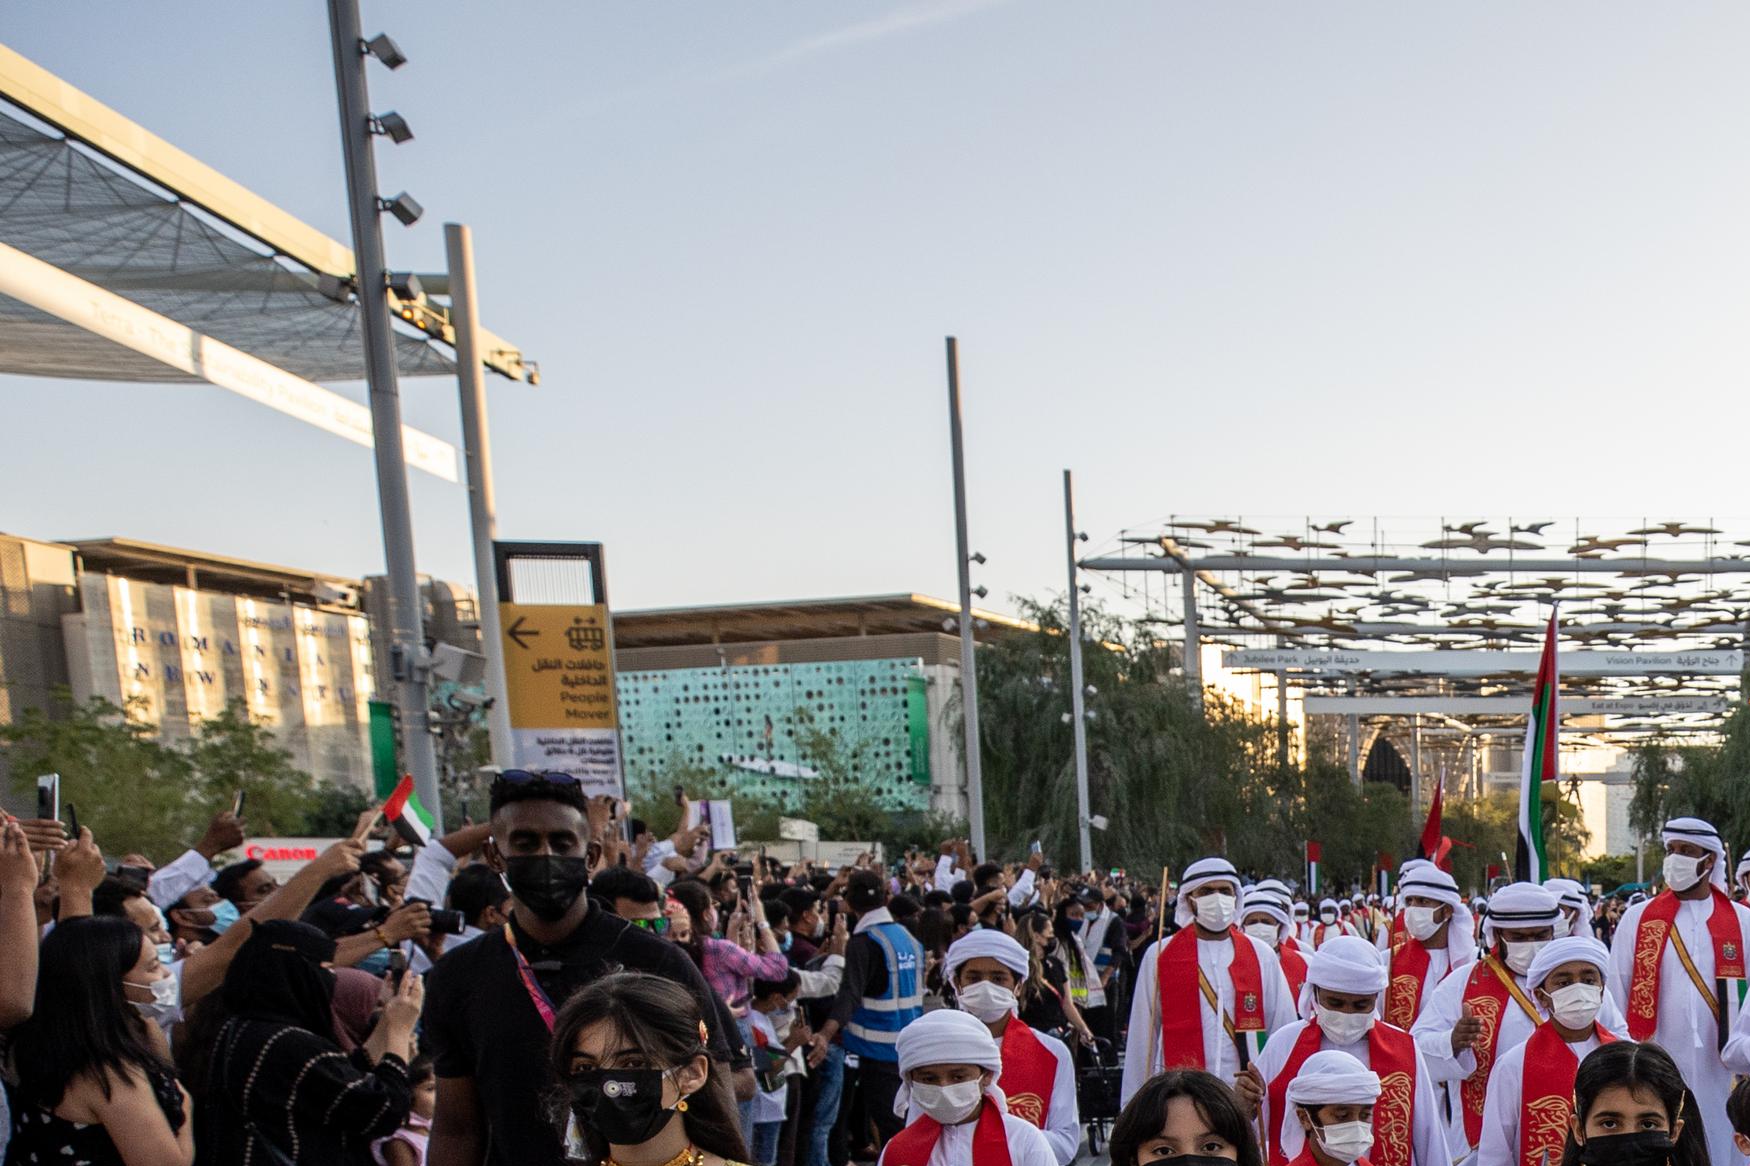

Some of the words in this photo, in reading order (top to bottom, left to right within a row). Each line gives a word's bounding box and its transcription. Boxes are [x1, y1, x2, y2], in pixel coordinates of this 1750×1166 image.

[132, 626, 325, 668] ROMANIA
[1243, 652, 1275, 664] Jubilee
[1278, 652, 1298, 663] Park
[1606, 656, 1633, 665] Vision
[1636, 656, 1672, 665] Pavilion
[1676, 656, 1699, 667] الرؤية
[1702, 656, 1720, 667] جناح
[560, 691, 608, 705] People
[1615, 702, 1634, 711] Expo
[565, 709, 609, 719] Mover
[245, 844, 317, 861] Canon
